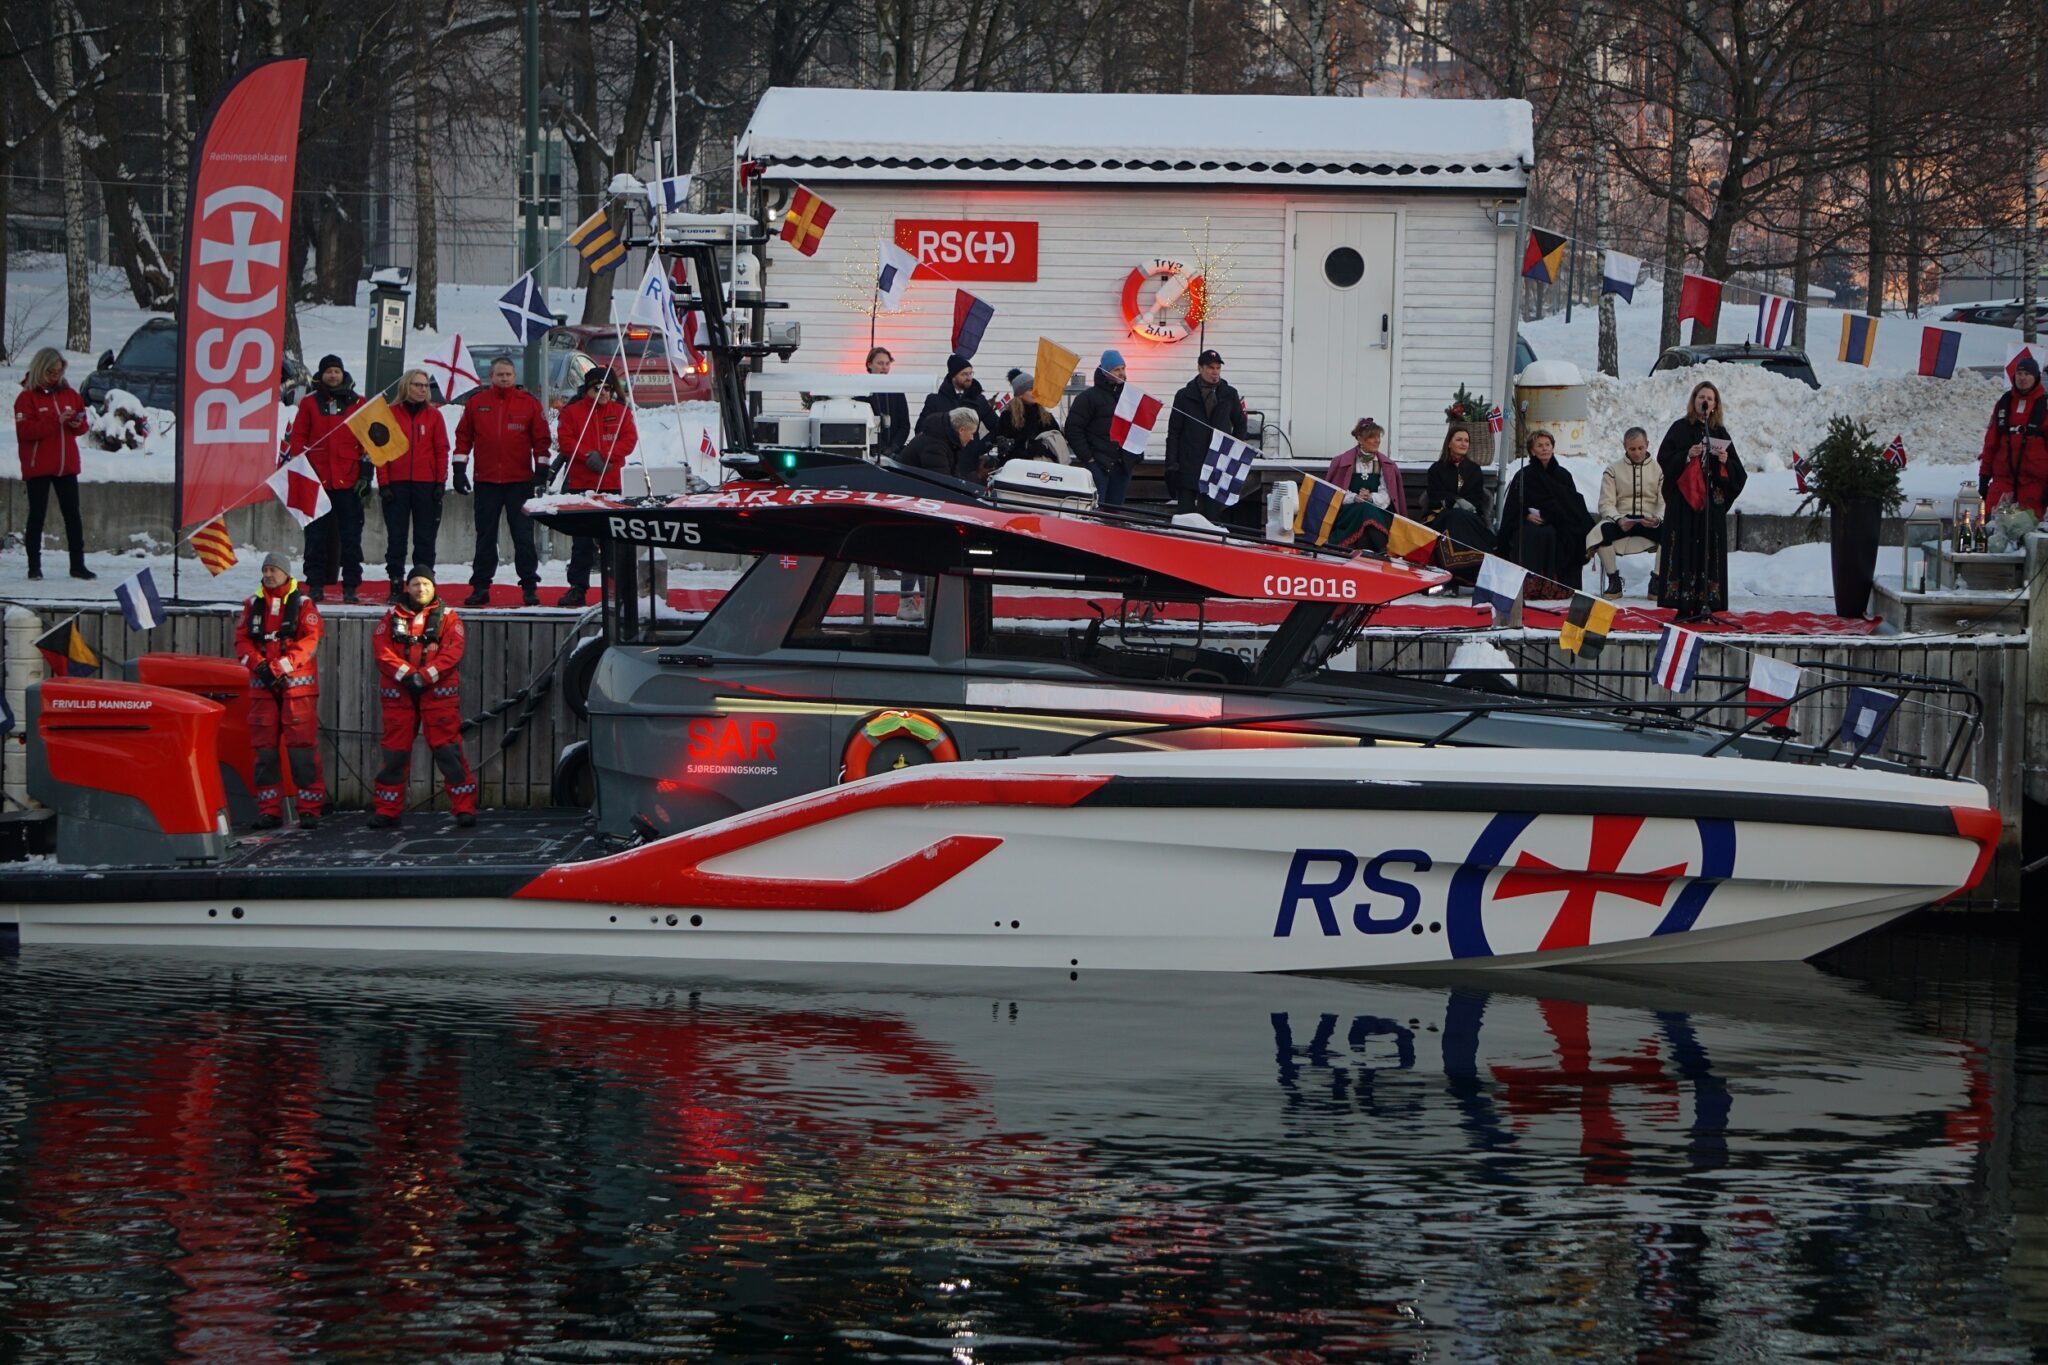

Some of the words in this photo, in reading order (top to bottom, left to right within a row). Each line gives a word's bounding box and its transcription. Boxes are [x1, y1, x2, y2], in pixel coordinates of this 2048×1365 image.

[209, 152, 288, 163] Redningsselskapet
[685, 489, 778, 507] SAR
[787, 488, 945, 511] RS175
[608, 516, 701, 545] RS175
[52, 699, 97, 709] FRIVILLIG
[98, 700, 153, 710] MANNSKAP
[687, 719, 778, 761] SAR
[687, 764, 778, 776] SJØREDNINGSKORPS
